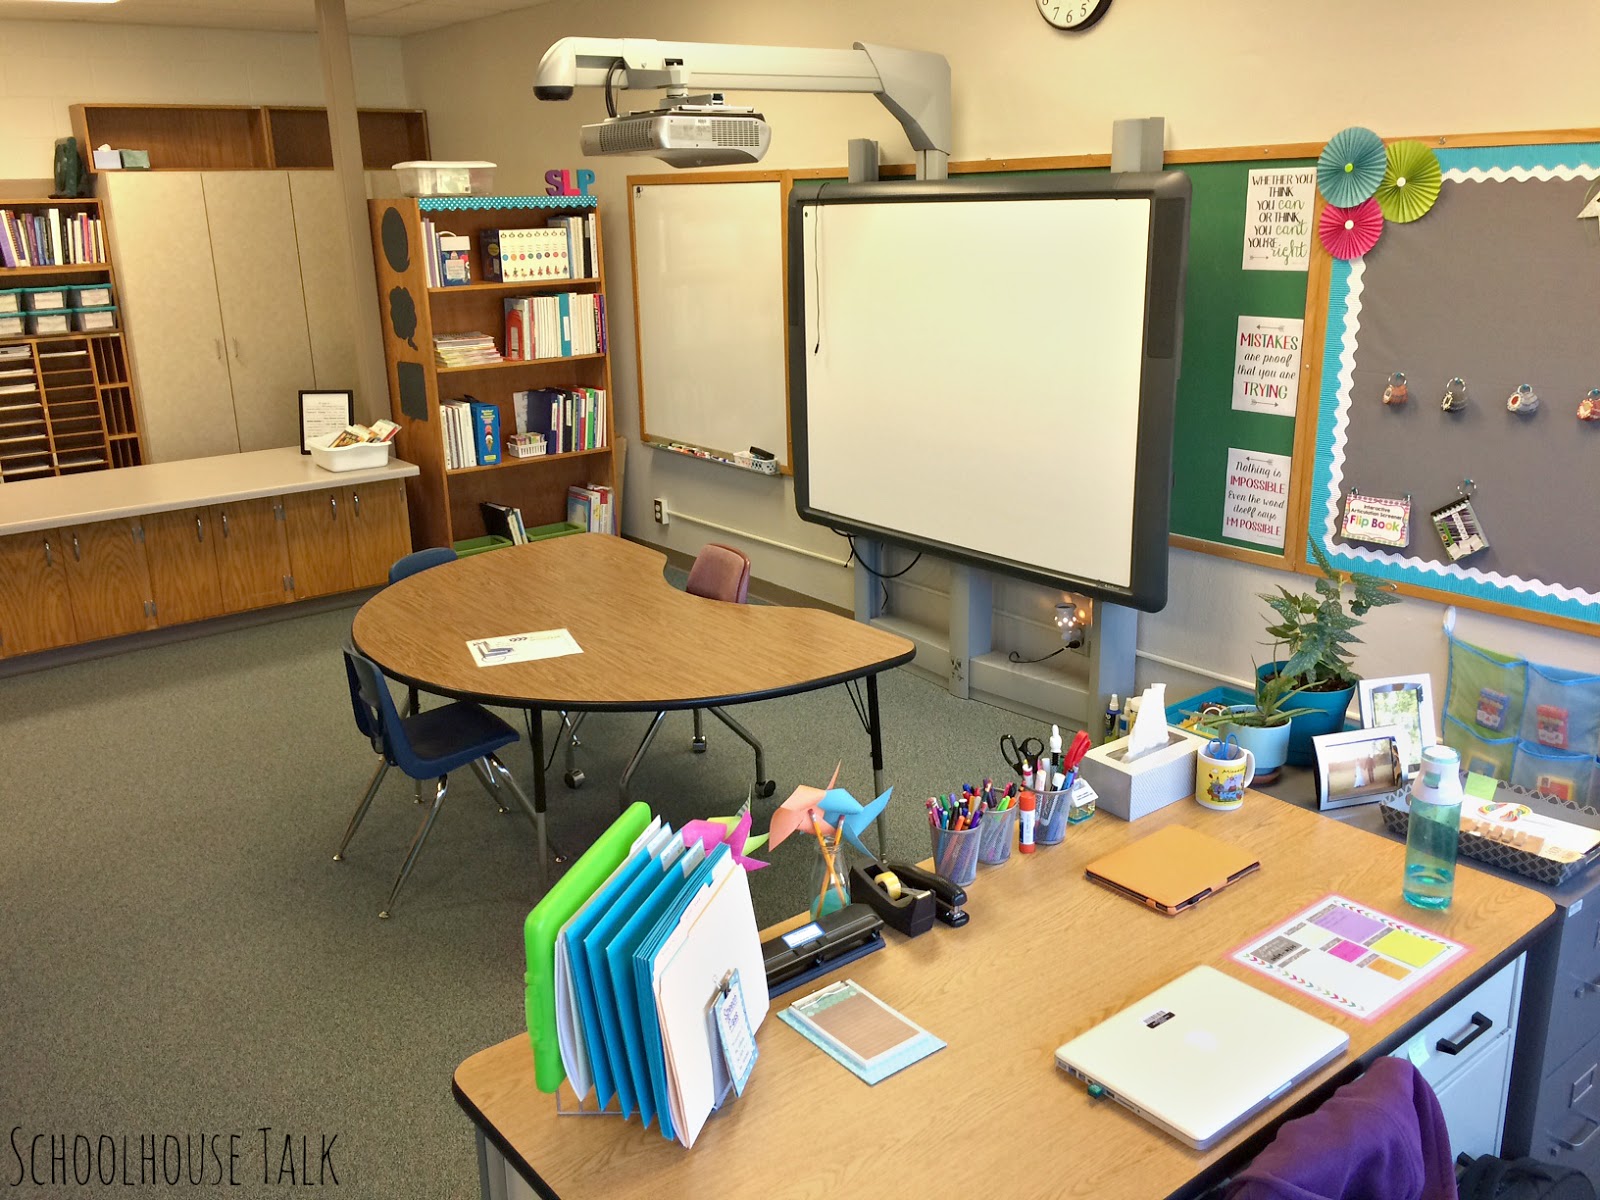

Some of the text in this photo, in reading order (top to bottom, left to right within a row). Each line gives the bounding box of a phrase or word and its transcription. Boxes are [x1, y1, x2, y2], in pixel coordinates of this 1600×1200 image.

[1053, 7, 1060, 20] 7
[1066, 10, 1073, 23] 6
[1080, 4, 1087, 17] 5
[544, 169, 596, 196] SLP
[1252, 174, 1314, 186] WHETHER YOU
[1269, 187, 1294, 197] THINK
[1257, 200, 1304, 210] YOU can
[1259, 212, 1300, 222] OR THINK
[1254, 225, 1272, 235] YOU
[1271, 240, 1308, 265] right
[1240, 332, 1298, 350] MISTAKES
[1244, 353, 1293, 367] are proof
[1237, 364, 1296, 380] that you are
[1243, 381, 1288, 399] TRYING
[1235, 461, 1282, 478] Nothing is
[1230, 475, 1286, 494] IMPOSSIBLE
[1228, 490, 1285, 509] Even the word
[1233, 504, 1277, 522] itself says
[1350, 515, 1400, 532] Flip Book
